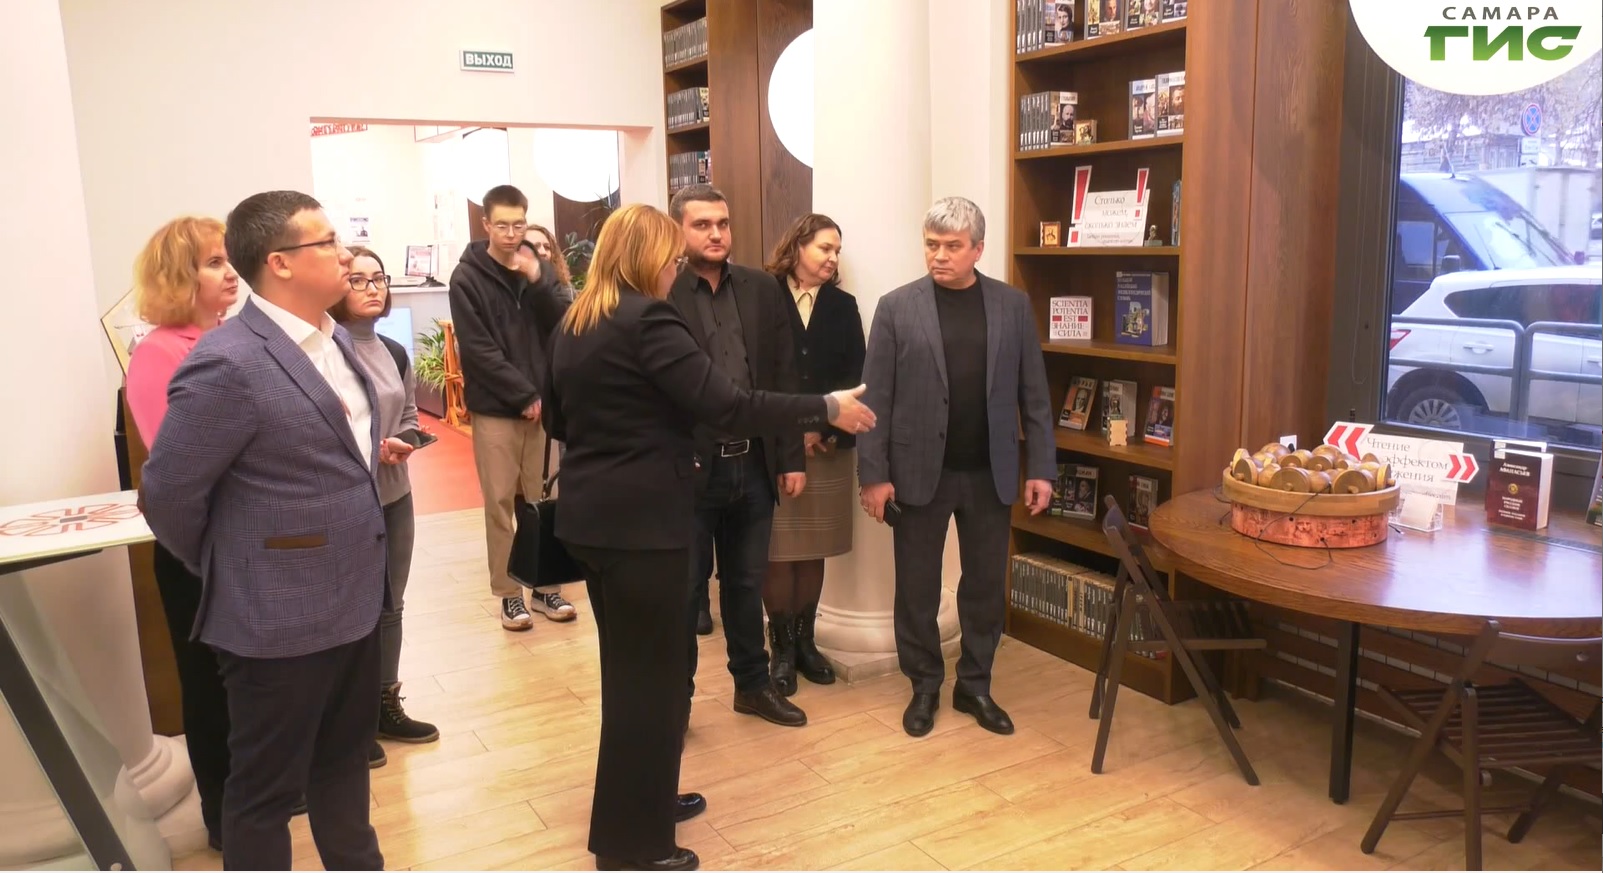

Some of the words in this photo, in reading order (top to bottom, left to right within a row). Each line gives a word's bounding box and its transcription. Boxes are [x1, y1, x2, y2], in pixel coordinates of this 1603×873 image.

[465, 53, 512, 68] ВЫХОД
[1052, 300, 1089, 308] SCIENTIA
[1052, 307, 1089, 315] POTENTIA
[1057, 330, 1082, 338] СИЛА
[1367, 437, 1411, 452] Чтение
[1382, 453, 1448, 470] эффектом
